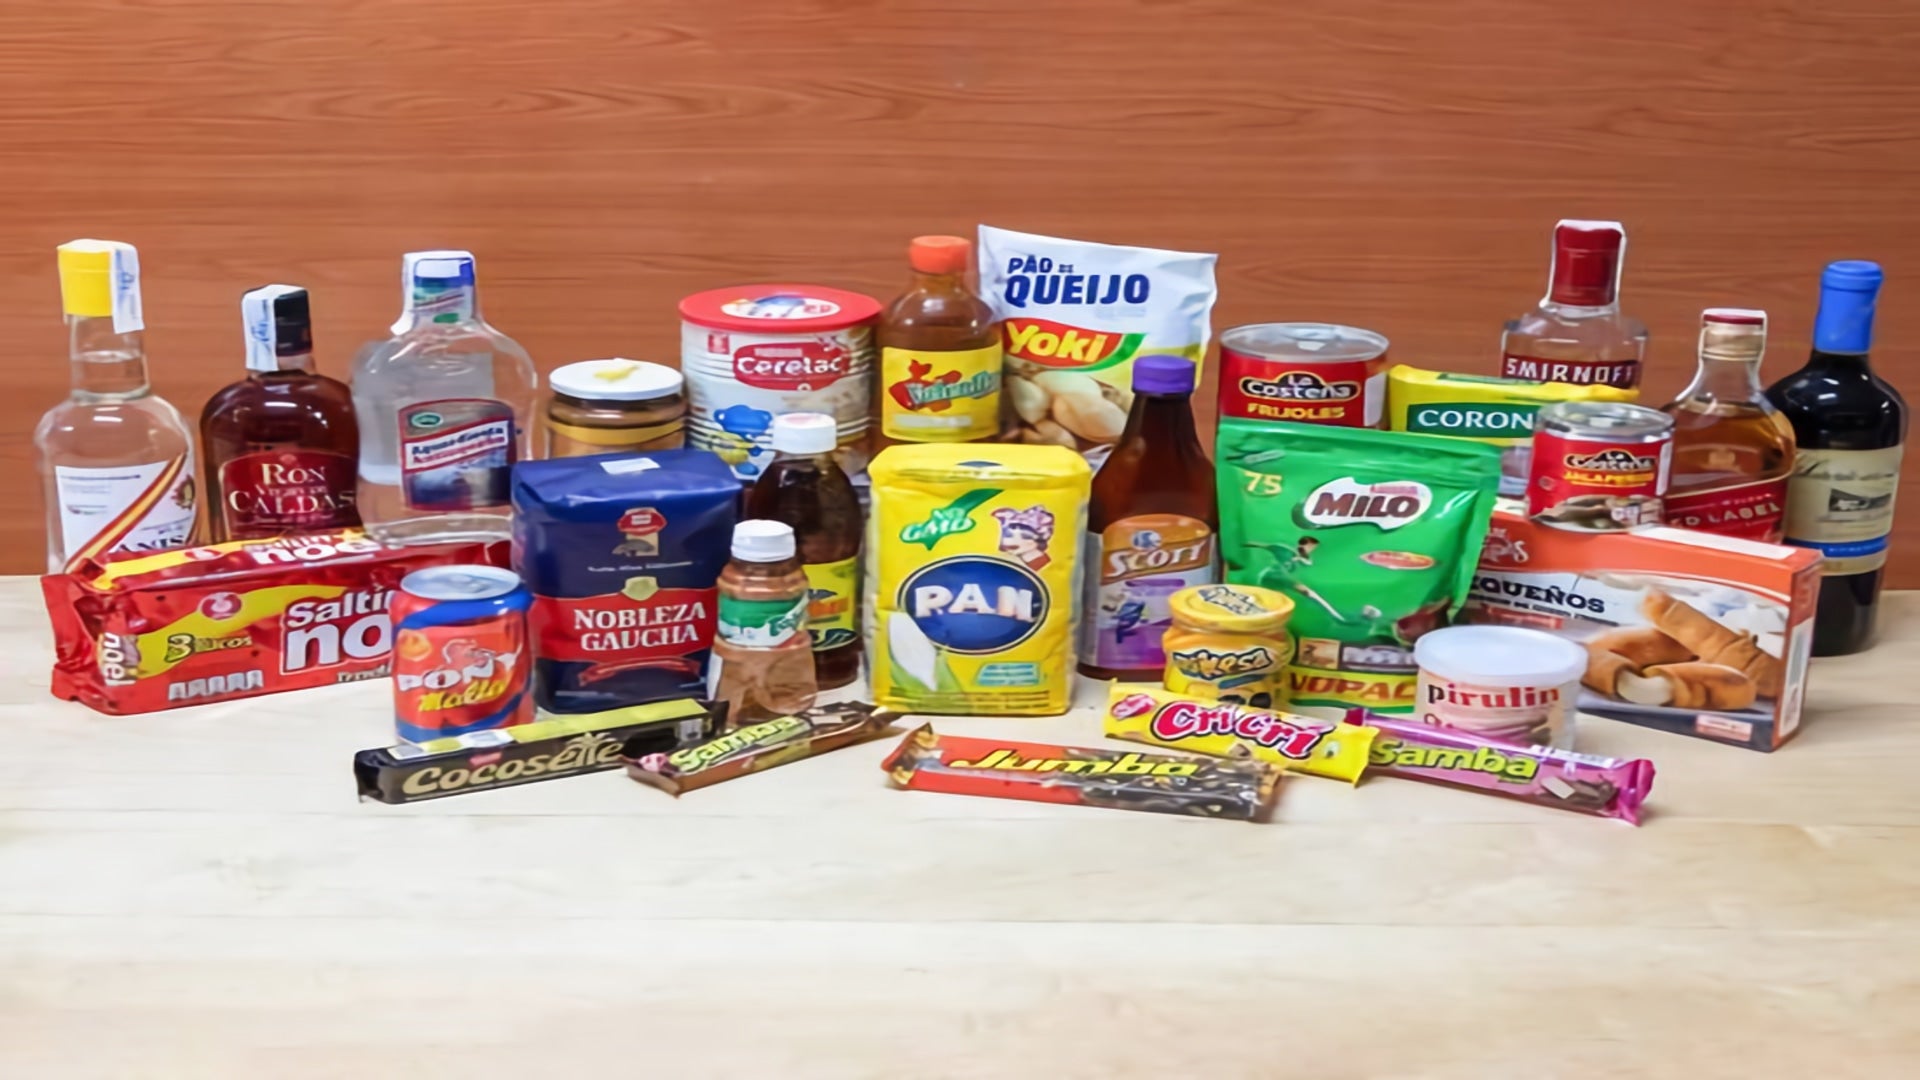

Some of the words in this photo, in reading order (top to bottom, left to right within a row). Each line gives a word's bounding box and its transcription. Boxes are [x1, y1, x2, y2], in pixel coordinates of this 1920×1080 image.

[1004, 274, 1150, 308] QUEIJO
[1006, 321, 1109, 363] Yoki
[737, 356, 843, 376] Cerelac
[1248, 403, 1345, 419] FRIJOLES
[1417, 409, 1534, 430] CORON
[1244, 472, 1282, 494] 75
[229, 489, 356, 514] CALDAS
[1312, 493, 1420, 518] MILO
[1707, 502, 1780, 523] LABEL
[574, 601, 706, 630] NOBLEZA
[286, 614, 392, 670] no
[580, 624, 699, 651] GAUCHA
[103, 632, 136, 686] noel
[1428, 683, 1560, 709] pirulin
[403, 733, 624, 795] Cocosette
[1367, 741, 1538, 779] Samba
